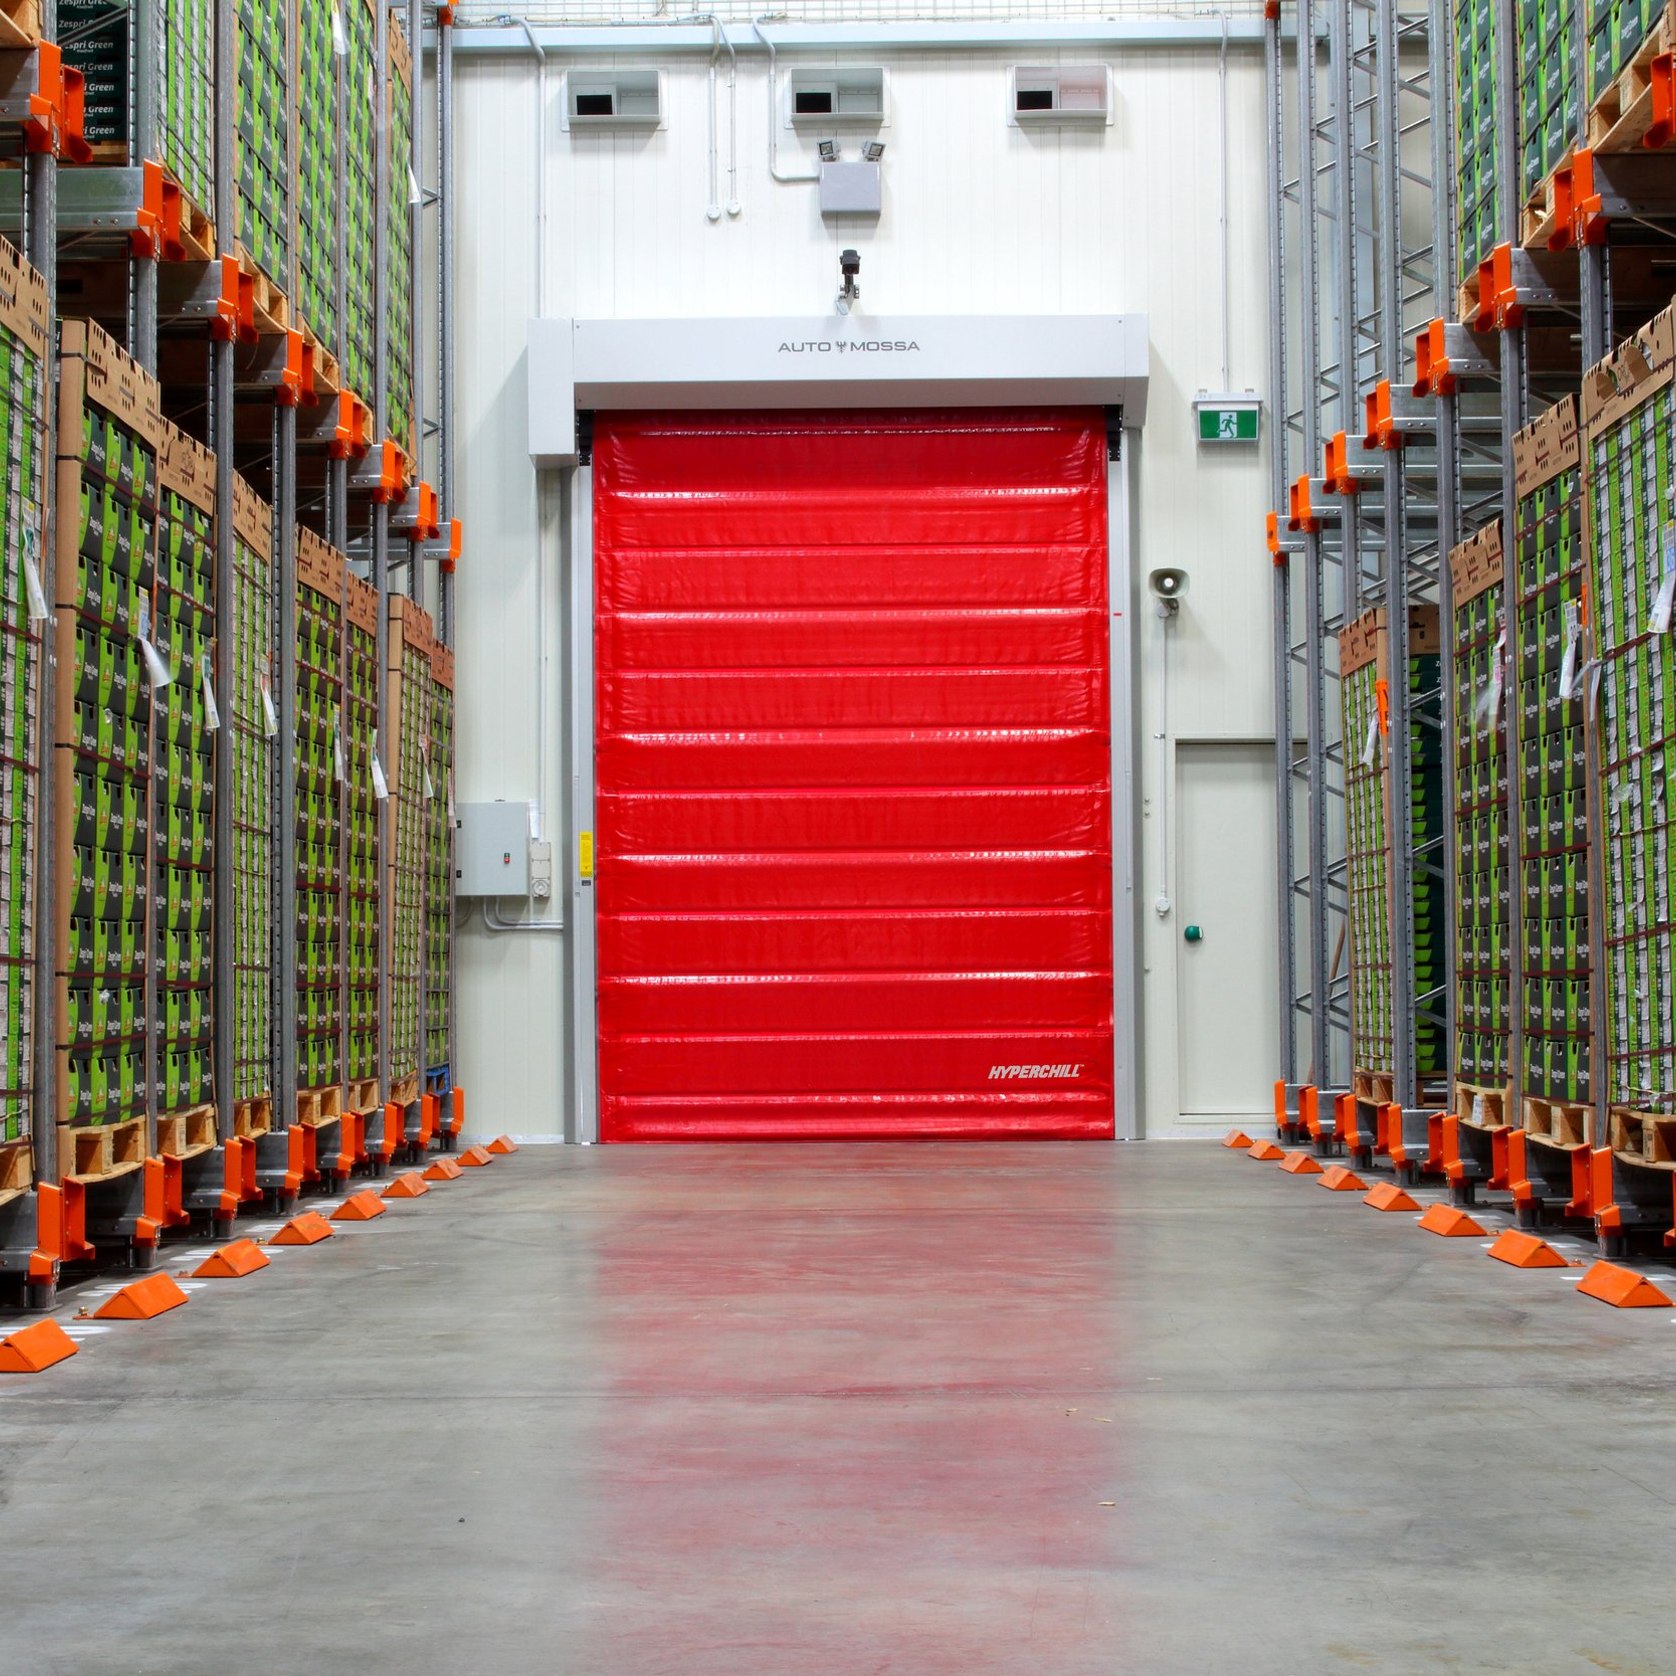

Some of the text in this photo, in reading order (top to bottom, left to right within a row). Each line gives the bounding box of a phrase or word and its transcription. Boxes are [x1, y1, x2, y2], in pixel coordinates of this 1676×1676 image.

[88, 41, 114, 49] Green
[88, 63, 113, 71] Green
[89, 83, 115, 91] Green
[89, 127, 115, 135] Green
[778, 341, 920, 353] AUTO MOSSA
